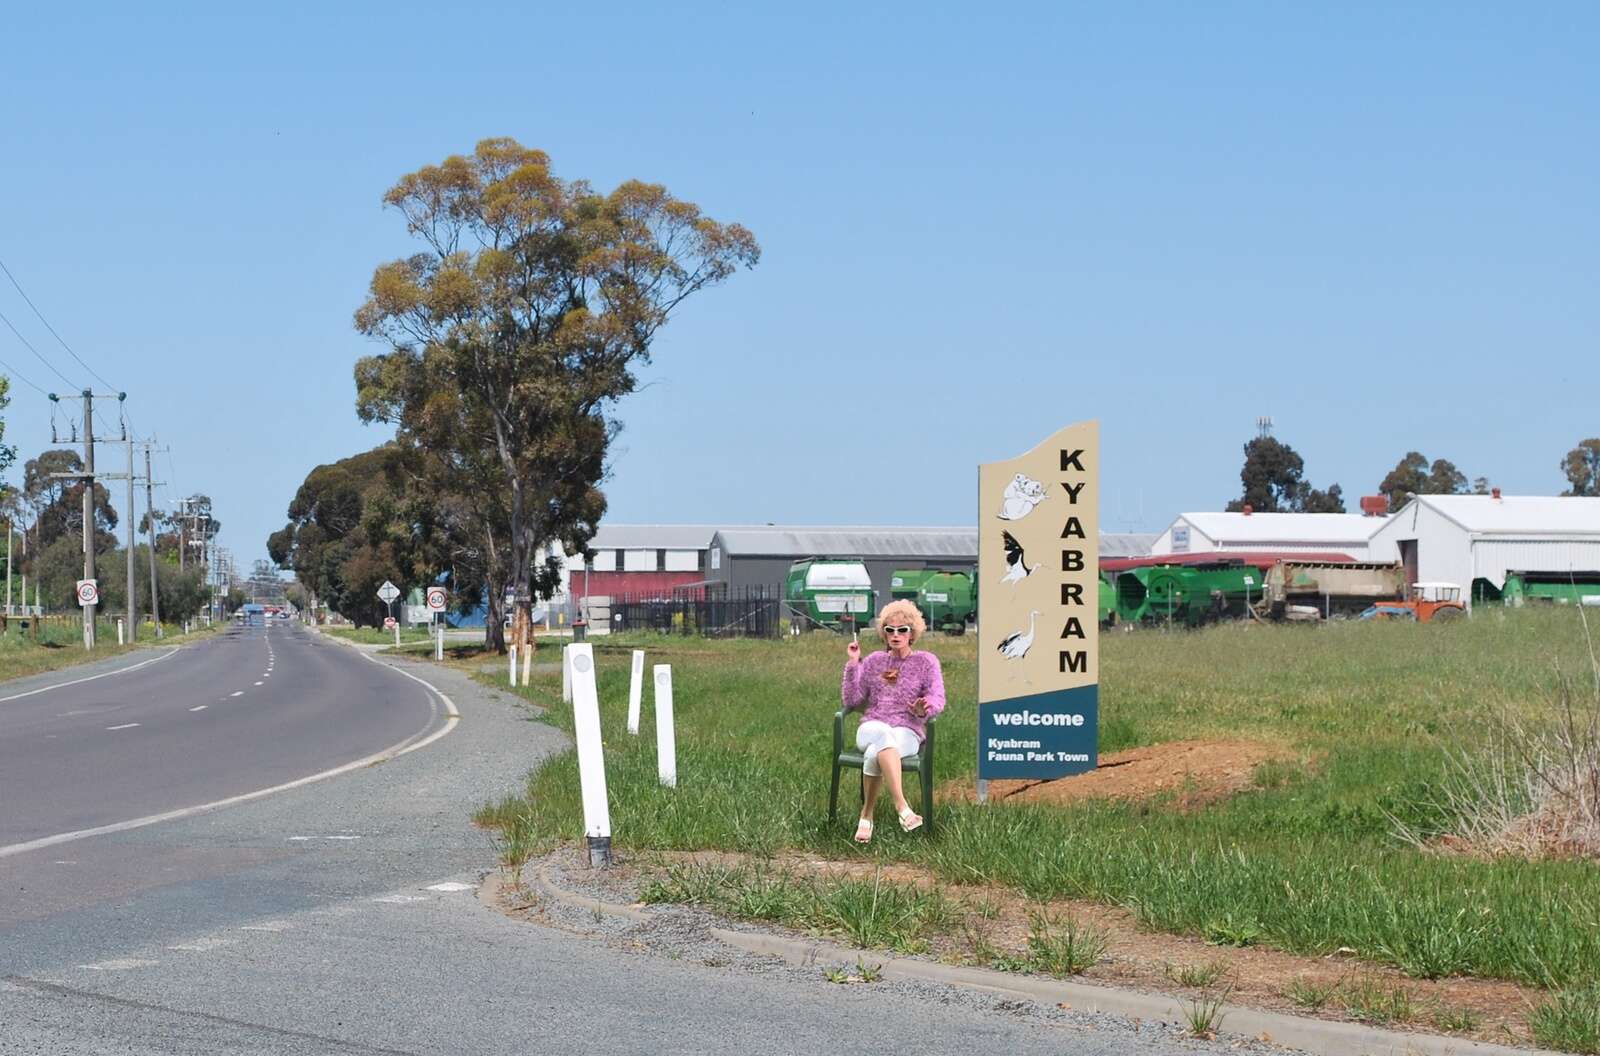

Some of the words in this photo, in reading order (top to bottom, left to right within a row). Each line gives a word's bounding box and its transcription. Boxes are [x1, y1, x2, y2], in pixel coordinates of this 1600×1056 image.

[1059, 449, 1087, 673] KYABRAM
[82, 587, 93, 597] 60
[431, 595, 443, 604] 60
[993, 710, 1084, 726] welcome
[988, 738, 1041, 750] Kyabram
[988, 752, 1024, 761] Fauna
[1027, 752, 1054, 762] Park
[1056, 752, 1089, 762] Town
